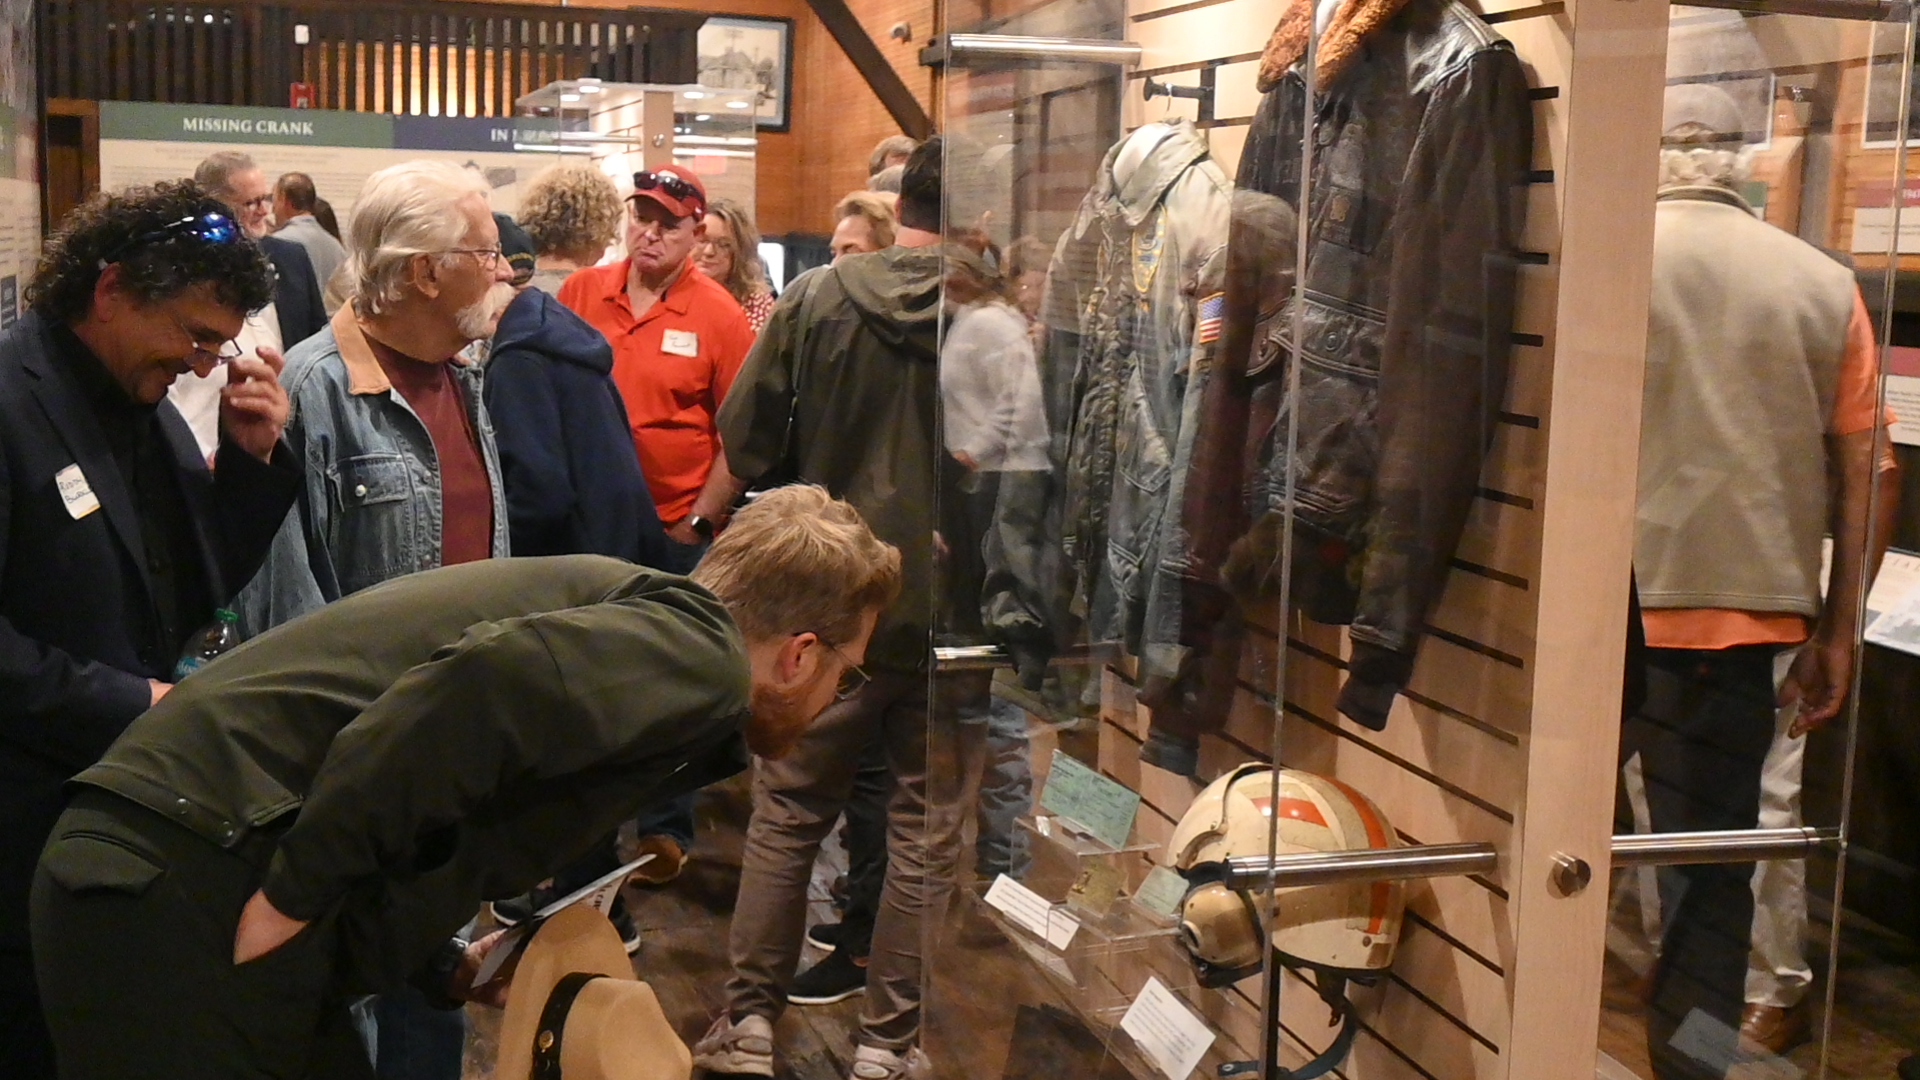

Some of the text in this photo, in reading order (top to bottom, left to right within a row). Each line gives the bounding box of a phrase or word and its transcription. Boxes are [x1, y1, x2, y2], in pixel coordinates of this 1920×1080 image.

[183, 117, 314, 135] MISSING CRANK
[490, 128, 508, 142] IN
